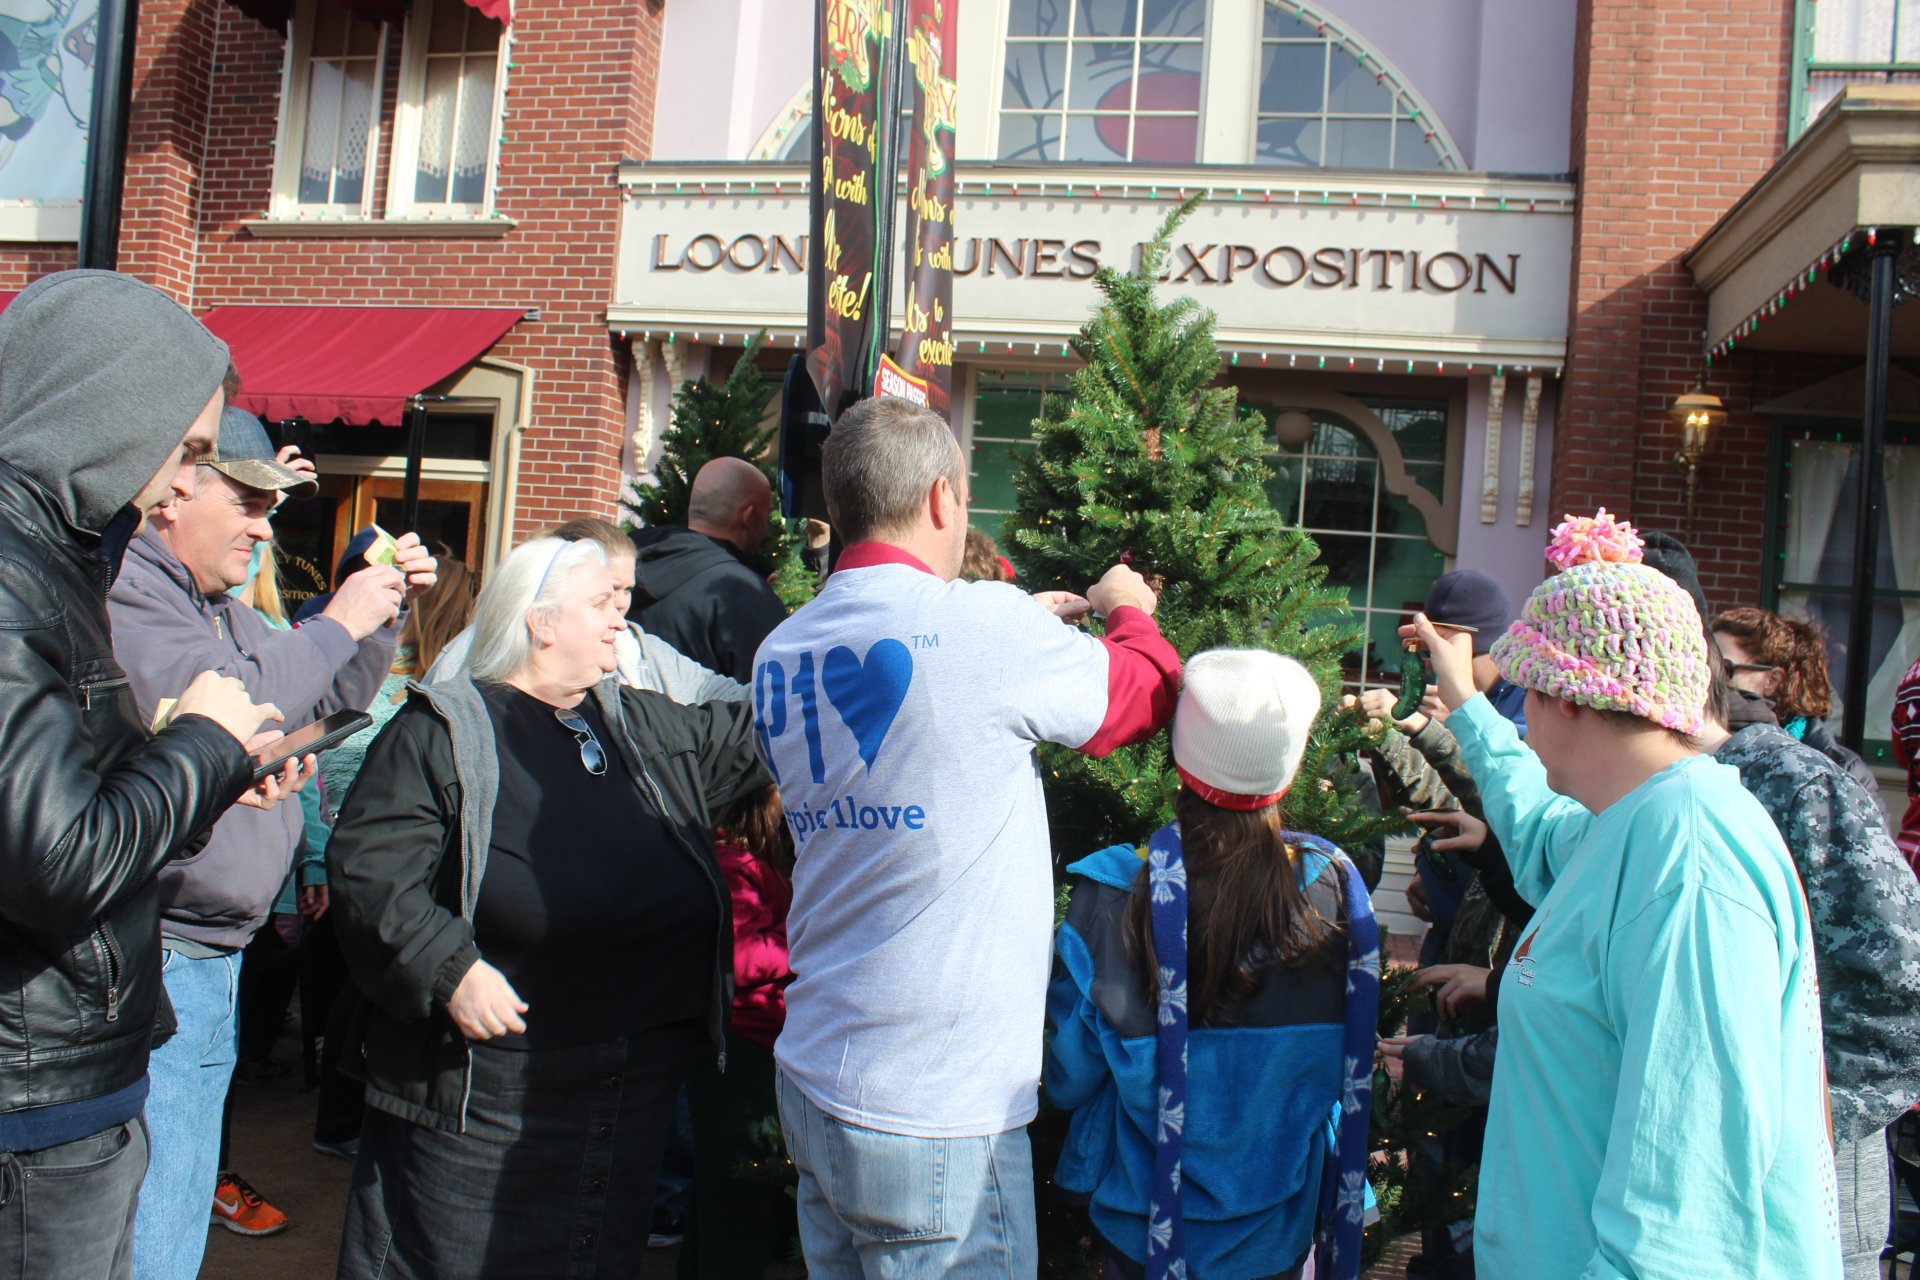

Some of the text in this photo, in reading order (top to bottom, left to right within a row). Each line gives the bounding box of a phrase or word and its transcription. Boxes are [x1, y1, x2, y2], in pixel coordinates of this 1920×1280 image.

[836, 171, 867, 205] with
[654, 233, 809, 271] LOON
[951, 236, 1102, 278] UNES
[881, 367, 906, 398] SEASON
[295, 556, 327, 591] TUNES
[912, 634, 939, 650] TM
